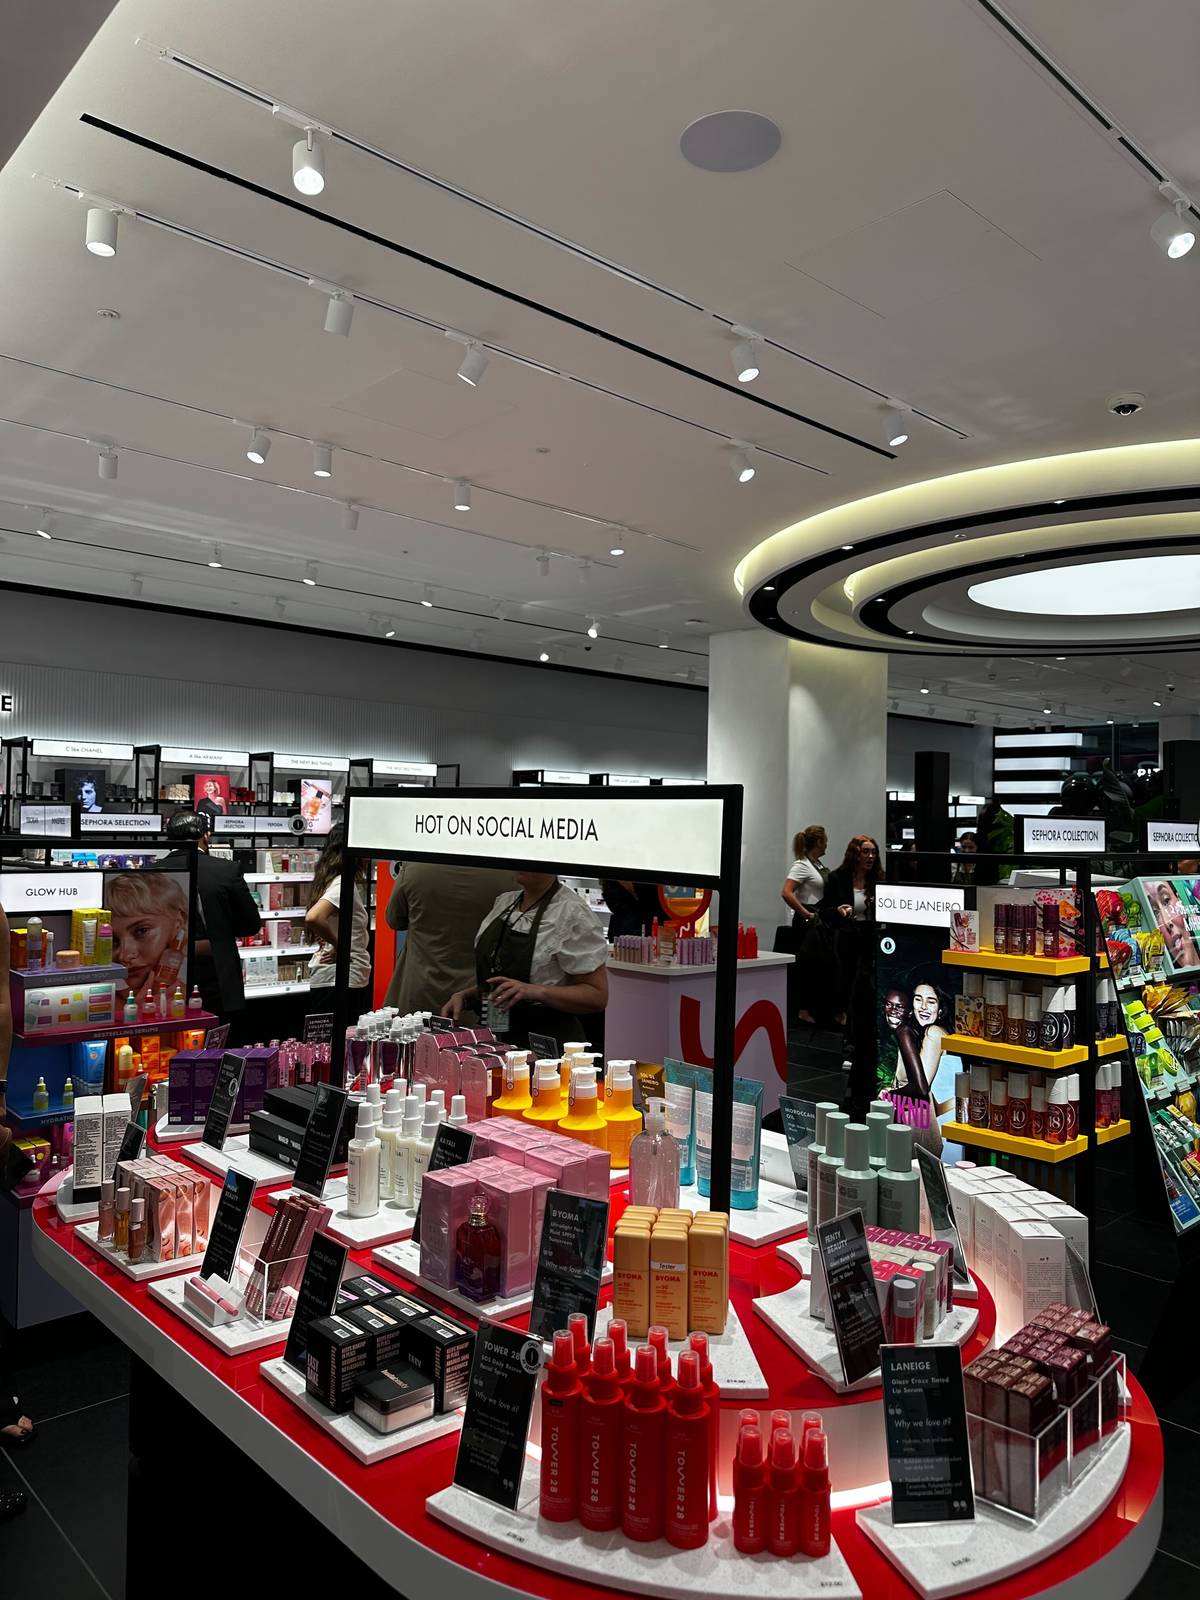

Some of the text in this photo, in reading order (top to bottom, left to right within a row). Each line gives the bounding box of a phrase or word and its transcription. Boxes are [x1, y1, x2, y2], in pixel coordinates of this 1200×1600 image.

[1, 695, 12, 712] E
[80, 818, 113, 826] SEPHORA
[415, 814, 599, 841] HOT ON SOCIAL MEDIA
[1032, 829, 1099, 841] SEPHORA COLLECTION
[1153, 831, 1199, 842] SEPHORA COLLECTIO
[25, 887, 78, 897] GLOW HUB
[878, 897, 961, 912] SOL DE JANEIRO
[785, 1107, 816, 1120] MOROCCAN
[881, 1092, 931, 1129] KND
[1013, 1111, 1025, 1120] 10
[39, 1115, 74, 1128] HYDRATIO
[552, 1209, 580, 1222] BYOMA
[824, 1230, 842, 1244] FENTY
[827, 1238, 848, 1255] BEAUTY
[617, 1273, 643, 1281] BYOMA
[693, 1270, 719, 1278] BYOMA
[484, 1341, 521, 1361] TOWER 28
[890, 1361, 931, 1372] LANEIGE
[891, 1378, 909, 1386] Glaze
[931, 1376, 950, 1384] Tinted
[892, 1387, 902, 1395] Lip
[475, 1391, 487, 1402] Why
[498, 1399, 511, 1410] love
[894, 1417, 953, 1430] Why we love it?
[550, 1424, 559, 1494] TOWER 28
[591, 1434, 600, 1503] TOWER 28
[628, 1442, 638, 1511] TOWER 28
[676, 1450, 686, 1520] TOWER 28
